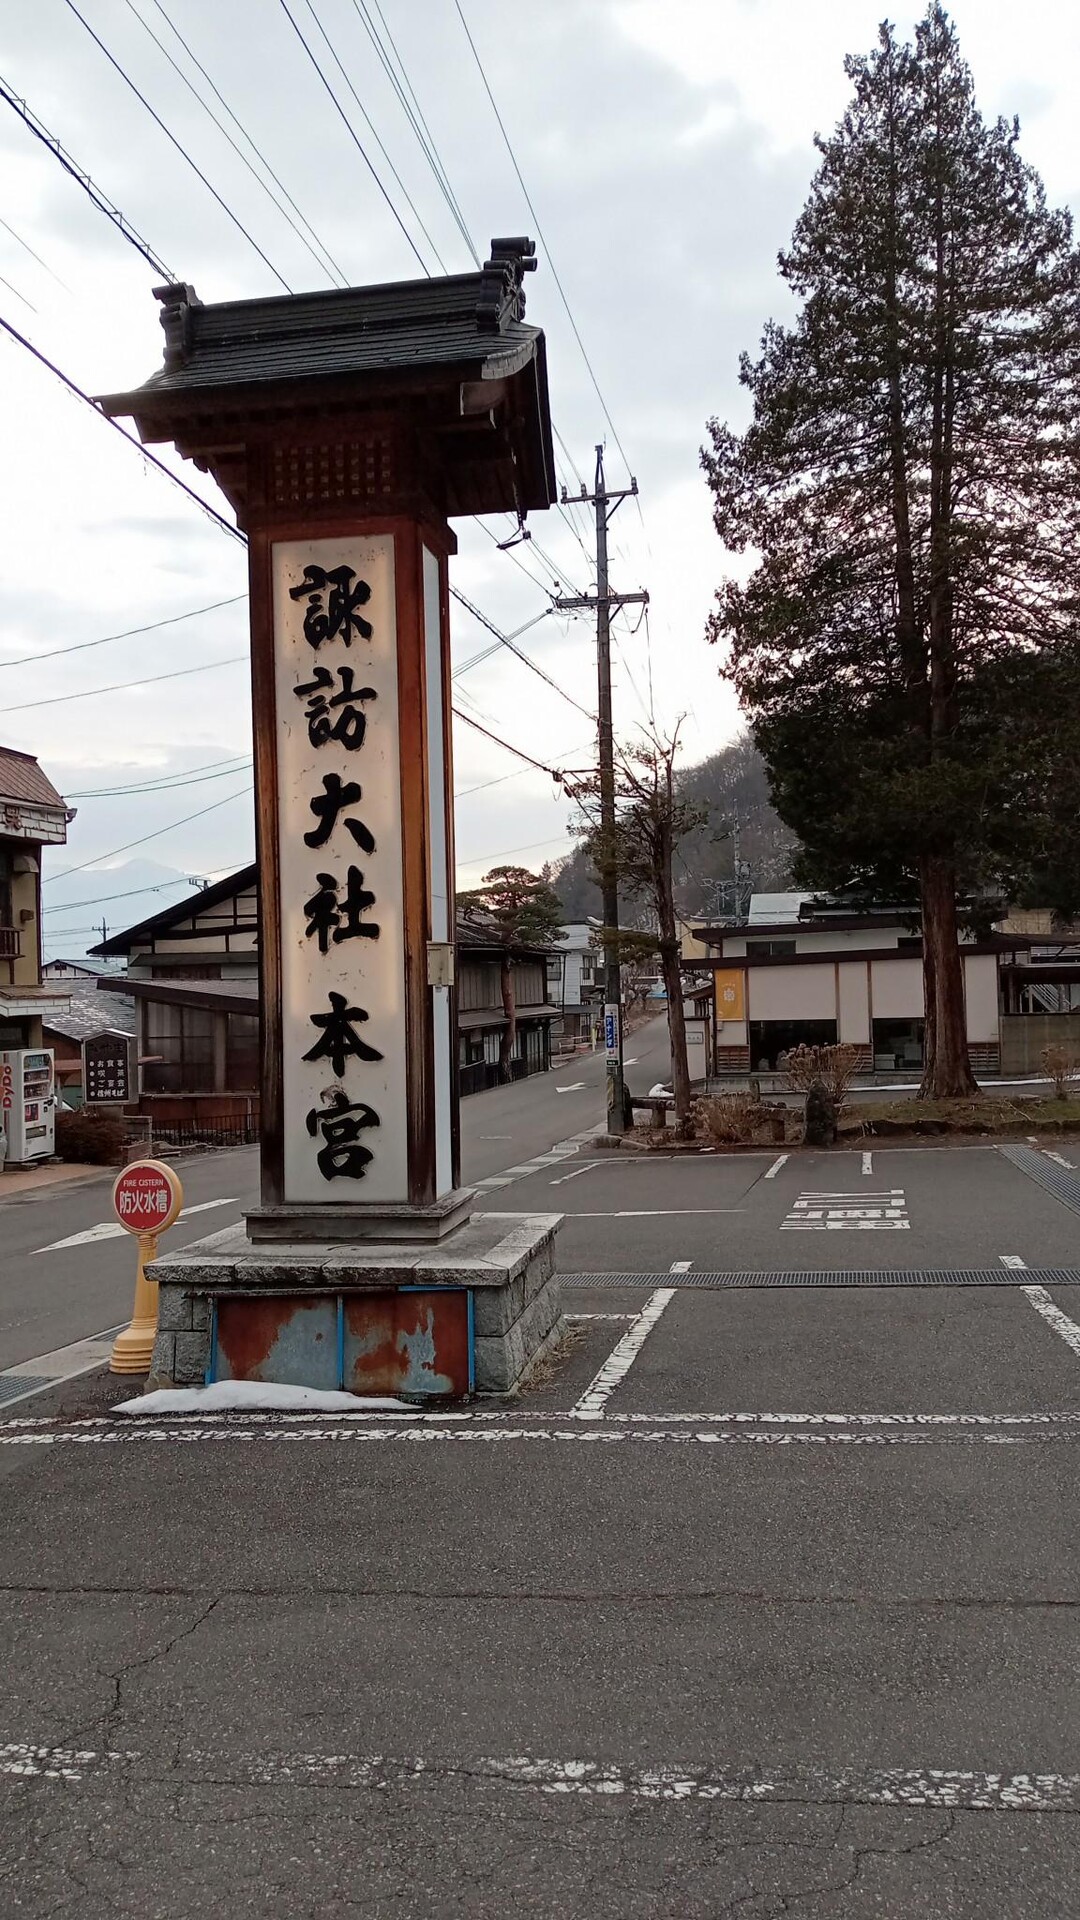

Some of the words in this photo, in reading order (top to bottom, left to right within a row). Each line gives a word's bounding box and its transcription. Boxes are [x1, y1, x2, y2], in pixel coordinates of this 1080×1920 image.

[123, 1179, 137, 1187] FIRE
[138, 1178, 164, 1187] CISTERN
[119, 1189, 168, 1214] 防火水槽
